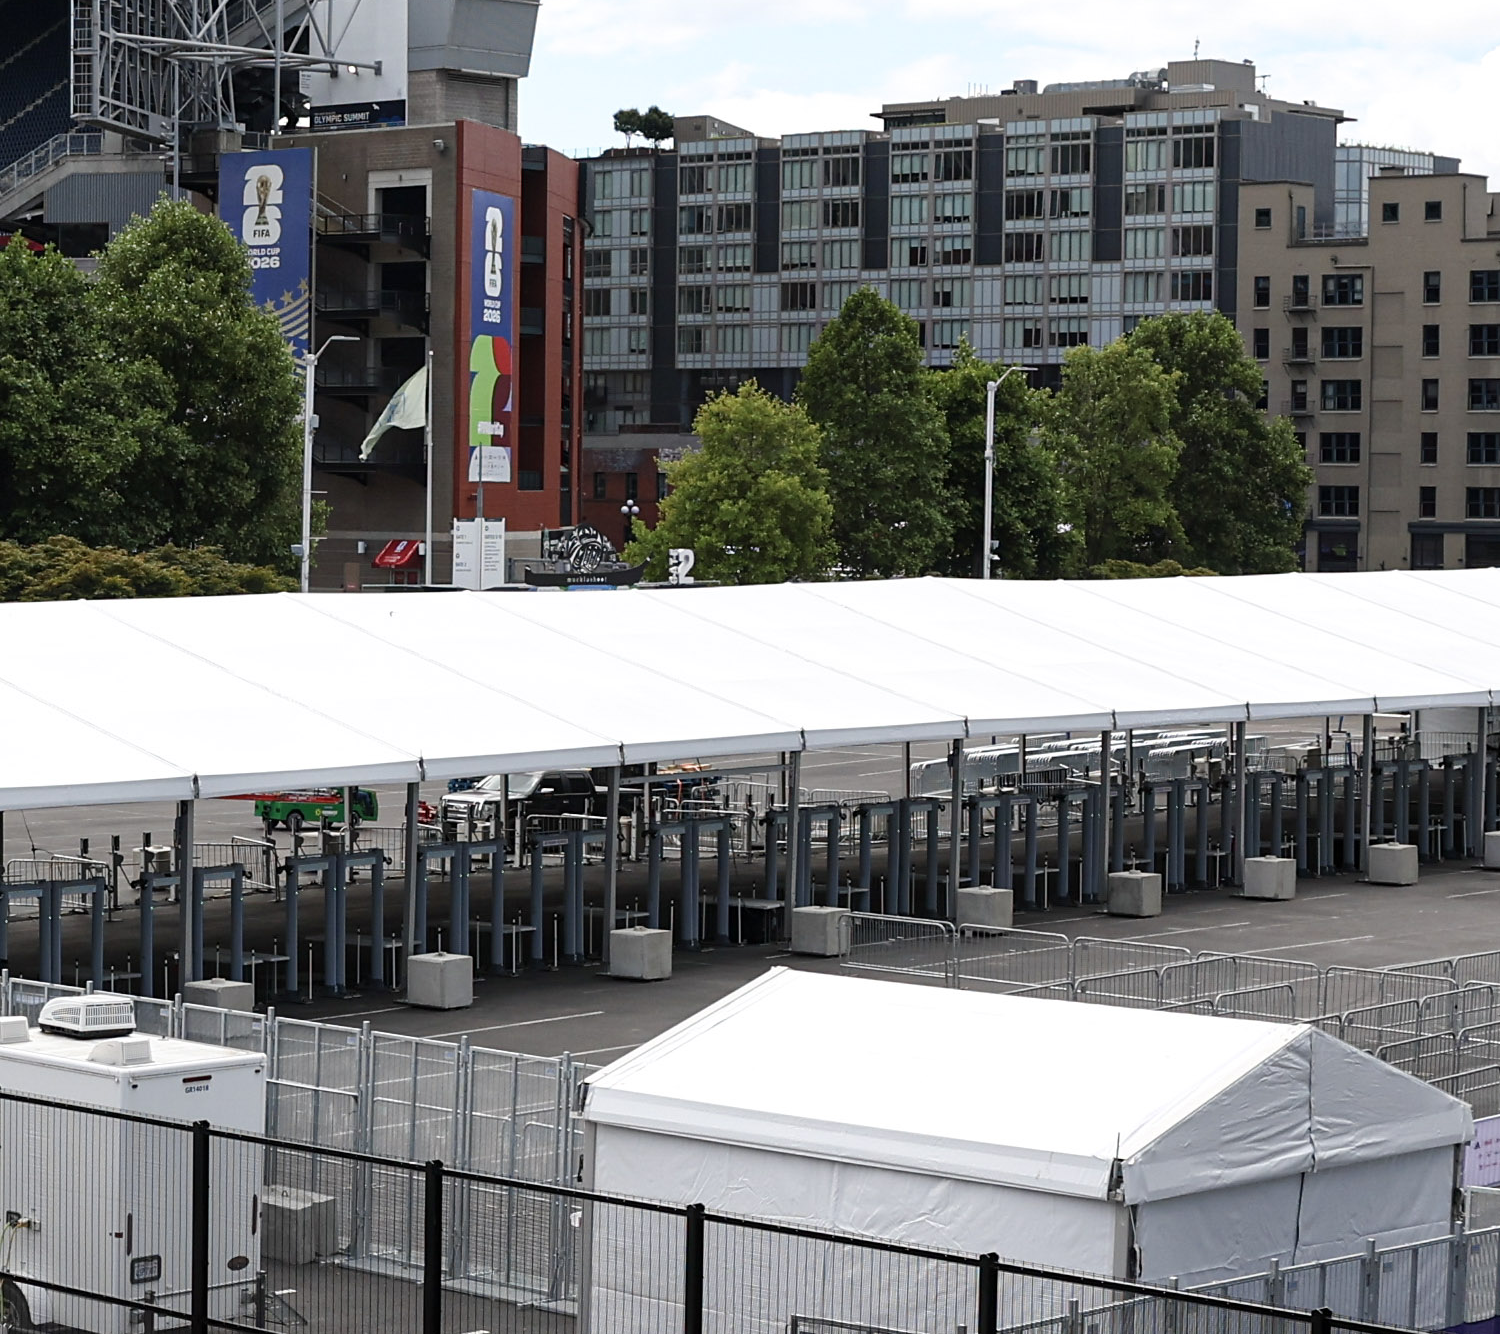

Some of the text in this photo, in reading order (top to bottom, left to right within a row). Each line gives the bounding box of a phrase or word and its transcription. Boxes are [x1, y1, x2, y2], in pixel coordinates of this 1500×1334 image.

[314, 114, 342, 124] OLYMPIC
[343, 112, 370, 122] SUMMIT
[253, 229, 270, 238] FIFA
[246, 247, 281, 256] ORLD CUP
[483, 308, 501, 323] 2026
[678, 549, 695, 584] 2
